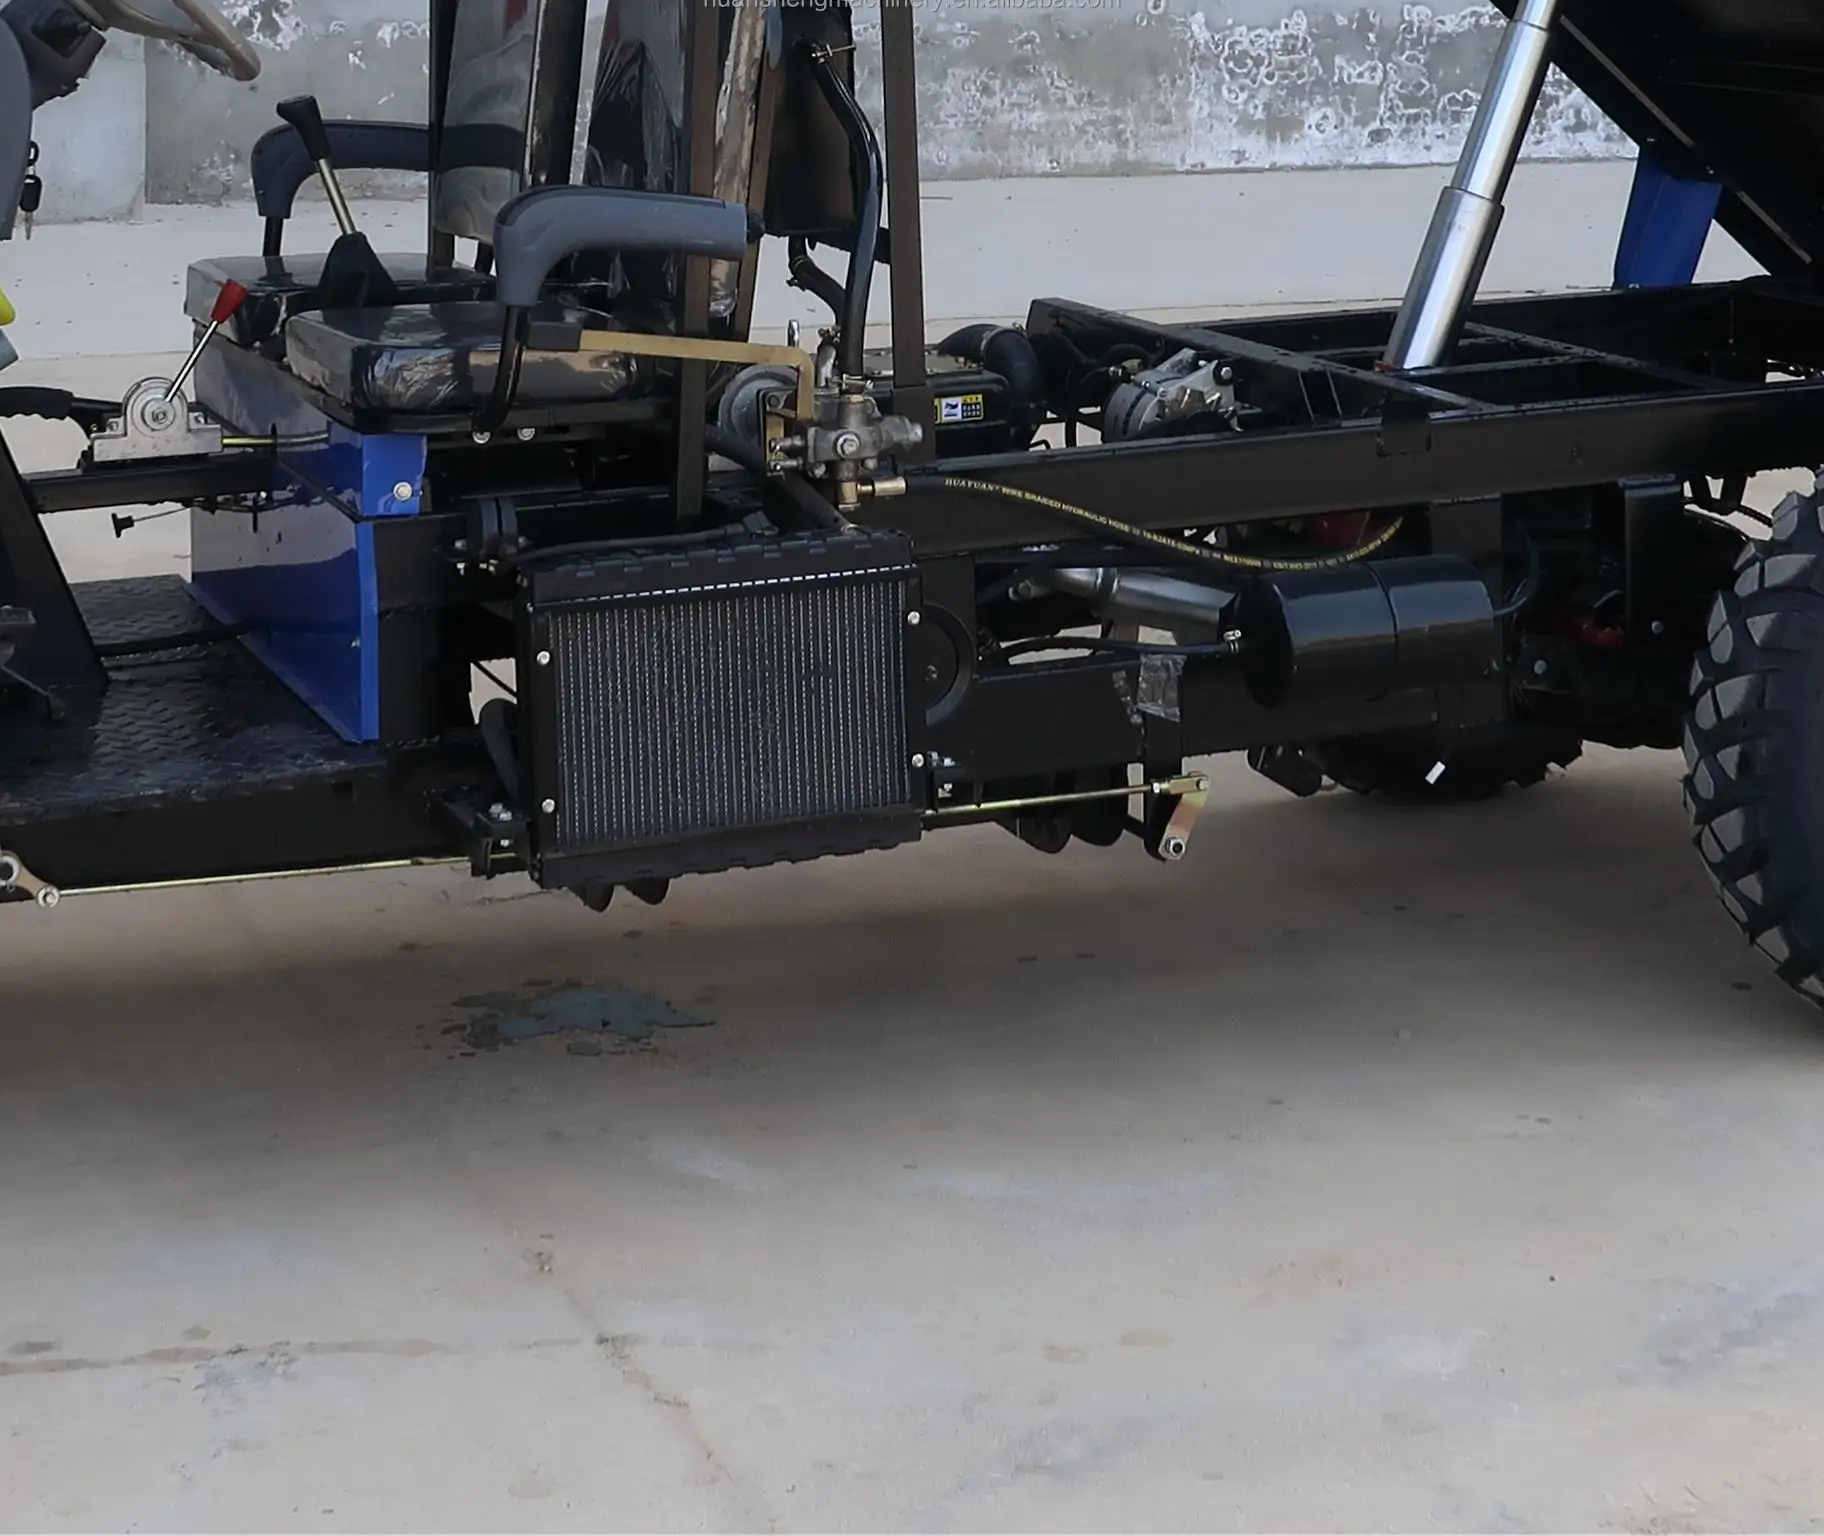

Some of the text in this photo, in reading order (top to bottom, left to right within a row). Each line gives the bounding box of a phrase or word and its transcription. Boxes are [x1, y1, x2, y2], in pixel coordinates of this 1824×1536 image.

[1001, 486, 1023, 499] WIRE
[1024, 491, 1061, 509] BRAIDED
[1062, 502, 1108, 525] HYDRAULIC
[1108, 515, 1130, 533] HOSE
